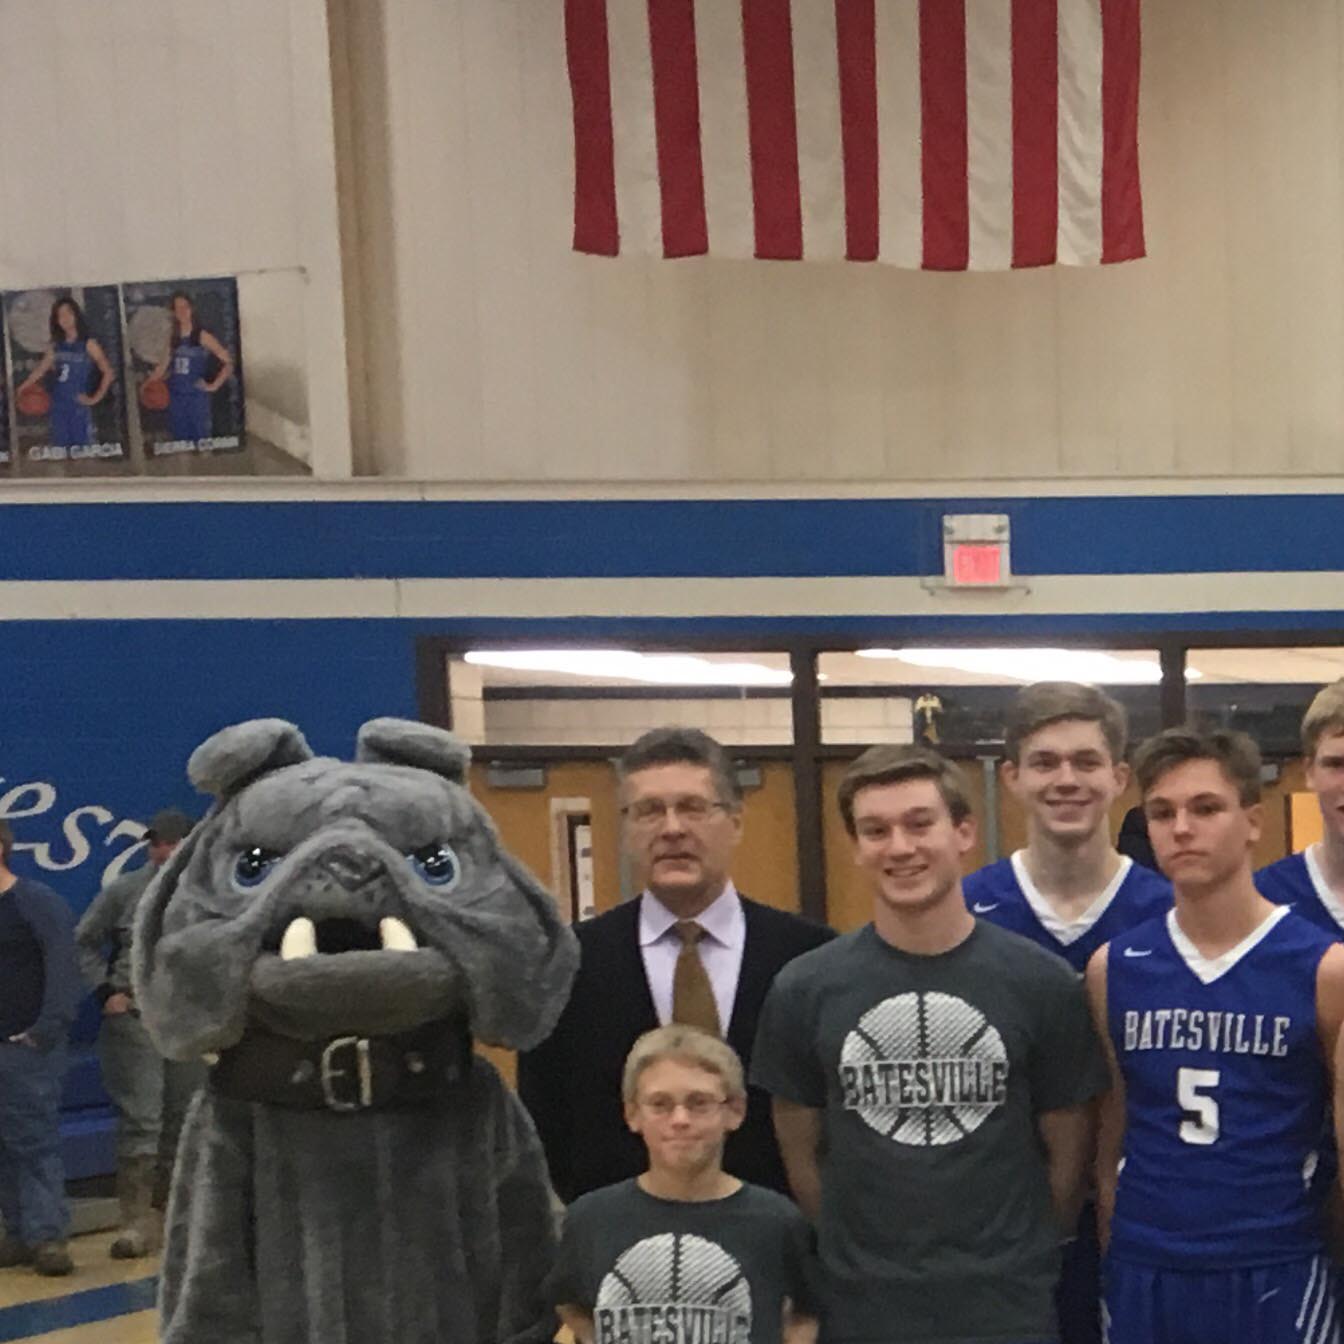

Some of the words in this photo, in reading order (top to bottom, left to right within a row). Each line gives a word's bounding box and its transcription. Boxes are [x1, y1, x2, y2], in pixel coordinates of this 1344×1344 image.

[1124, 1009, 1291, 1057] BATESVILLE
[839, 1058, 1009, 1110] BATESVILLE
[1177, 1067, 1220, 1145] 5
